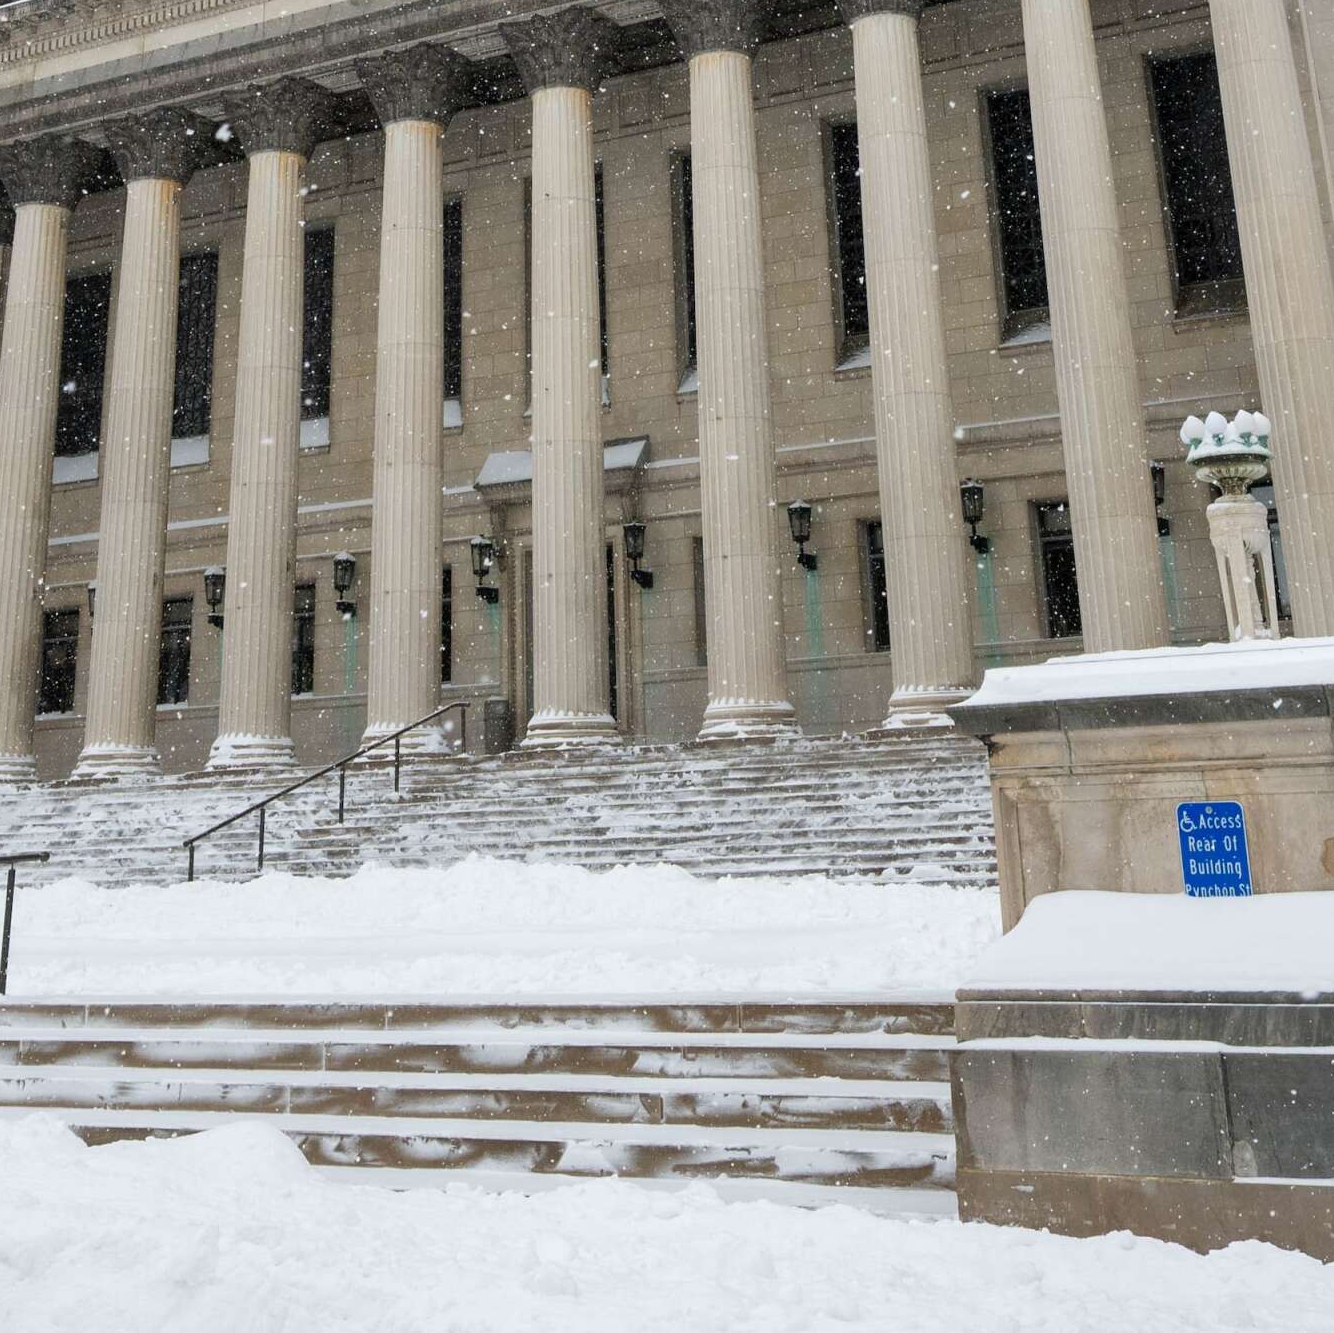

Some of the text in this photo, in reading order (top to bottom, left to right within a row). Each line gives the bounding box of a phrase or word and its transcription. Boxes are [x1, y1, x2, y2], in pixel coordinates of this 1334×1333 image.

[1199, 813, 1242, 829] Access
[1188, 835, 1237, 852] Rear Of
[1189, 858, 1242, 879] Building
